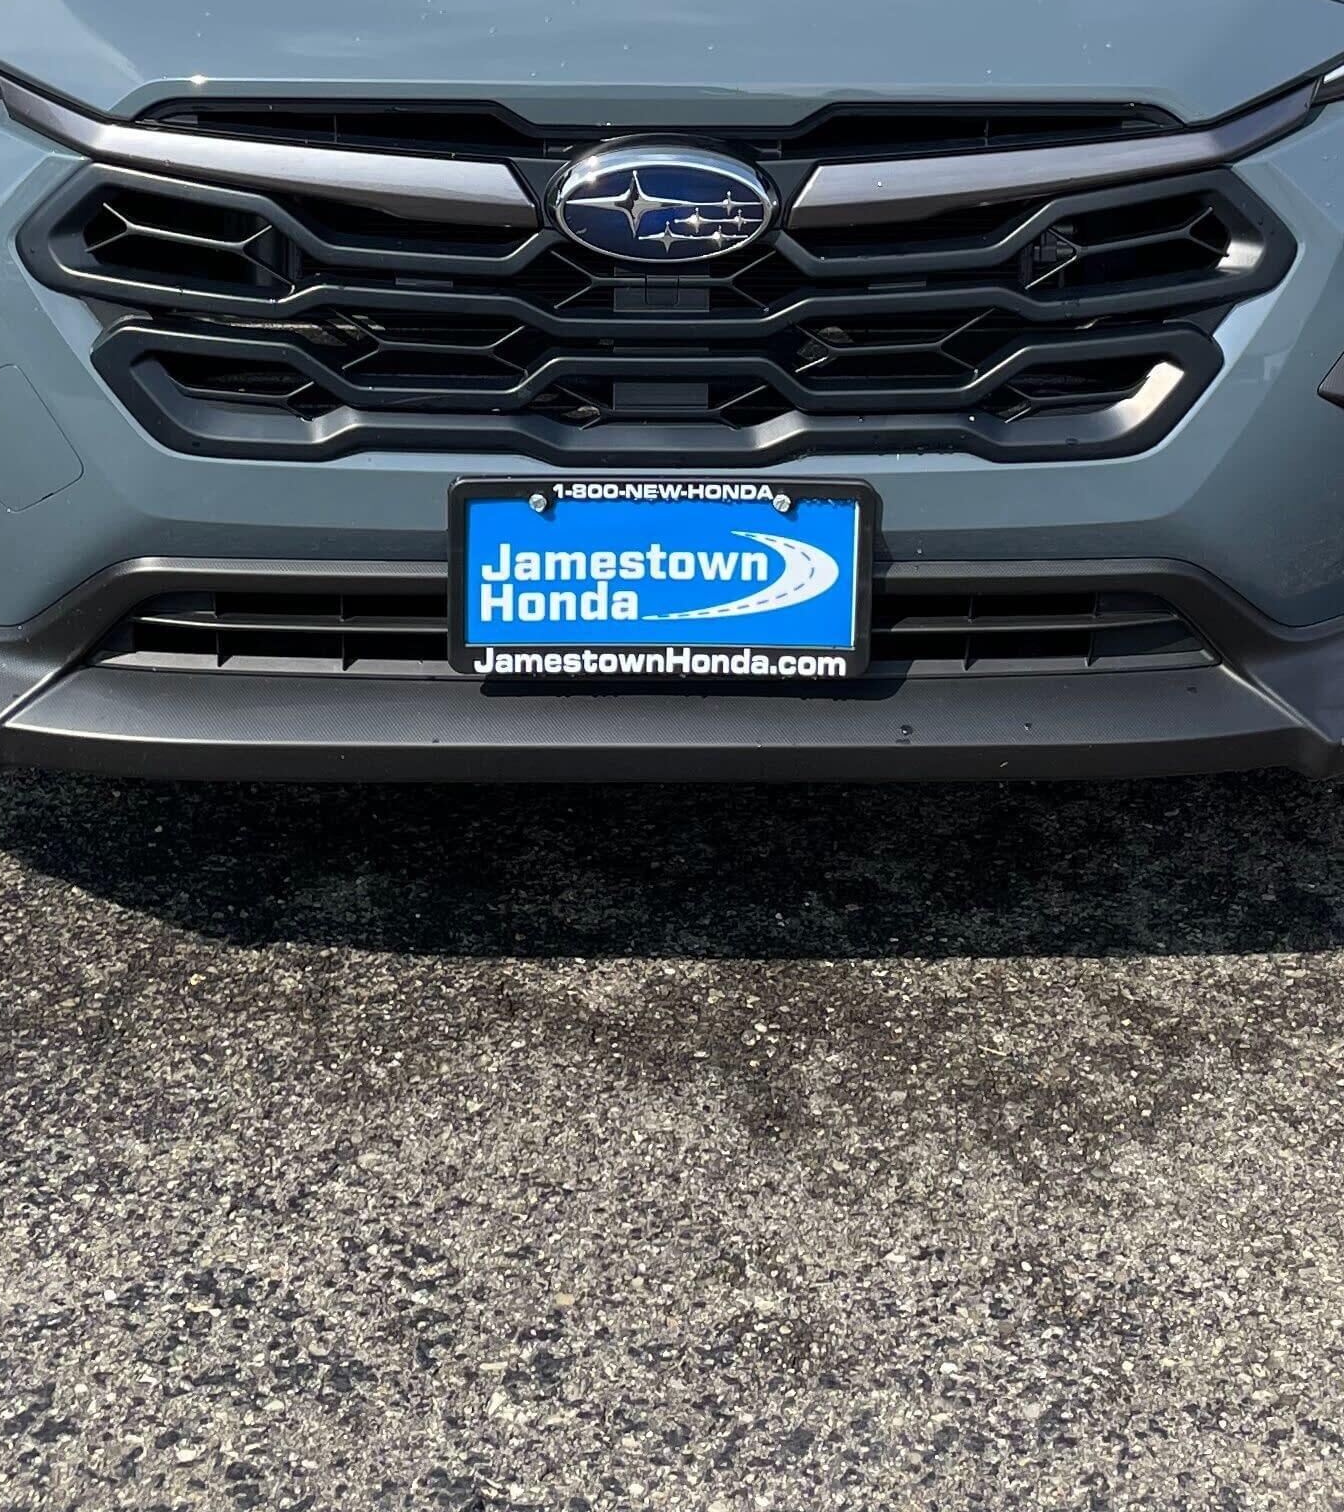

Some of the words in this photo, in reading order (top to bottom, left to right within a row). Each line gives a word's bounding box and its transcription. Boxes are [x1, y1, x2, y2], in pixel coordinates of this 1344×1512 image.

[552, 483, 774, 500] 1-800-NEW-HONDA
[481, 543, 768, 581] Jamestown
[480, 581, 639, 622] Honda
[473, 646, 847, 677] JamestownHonda.com
